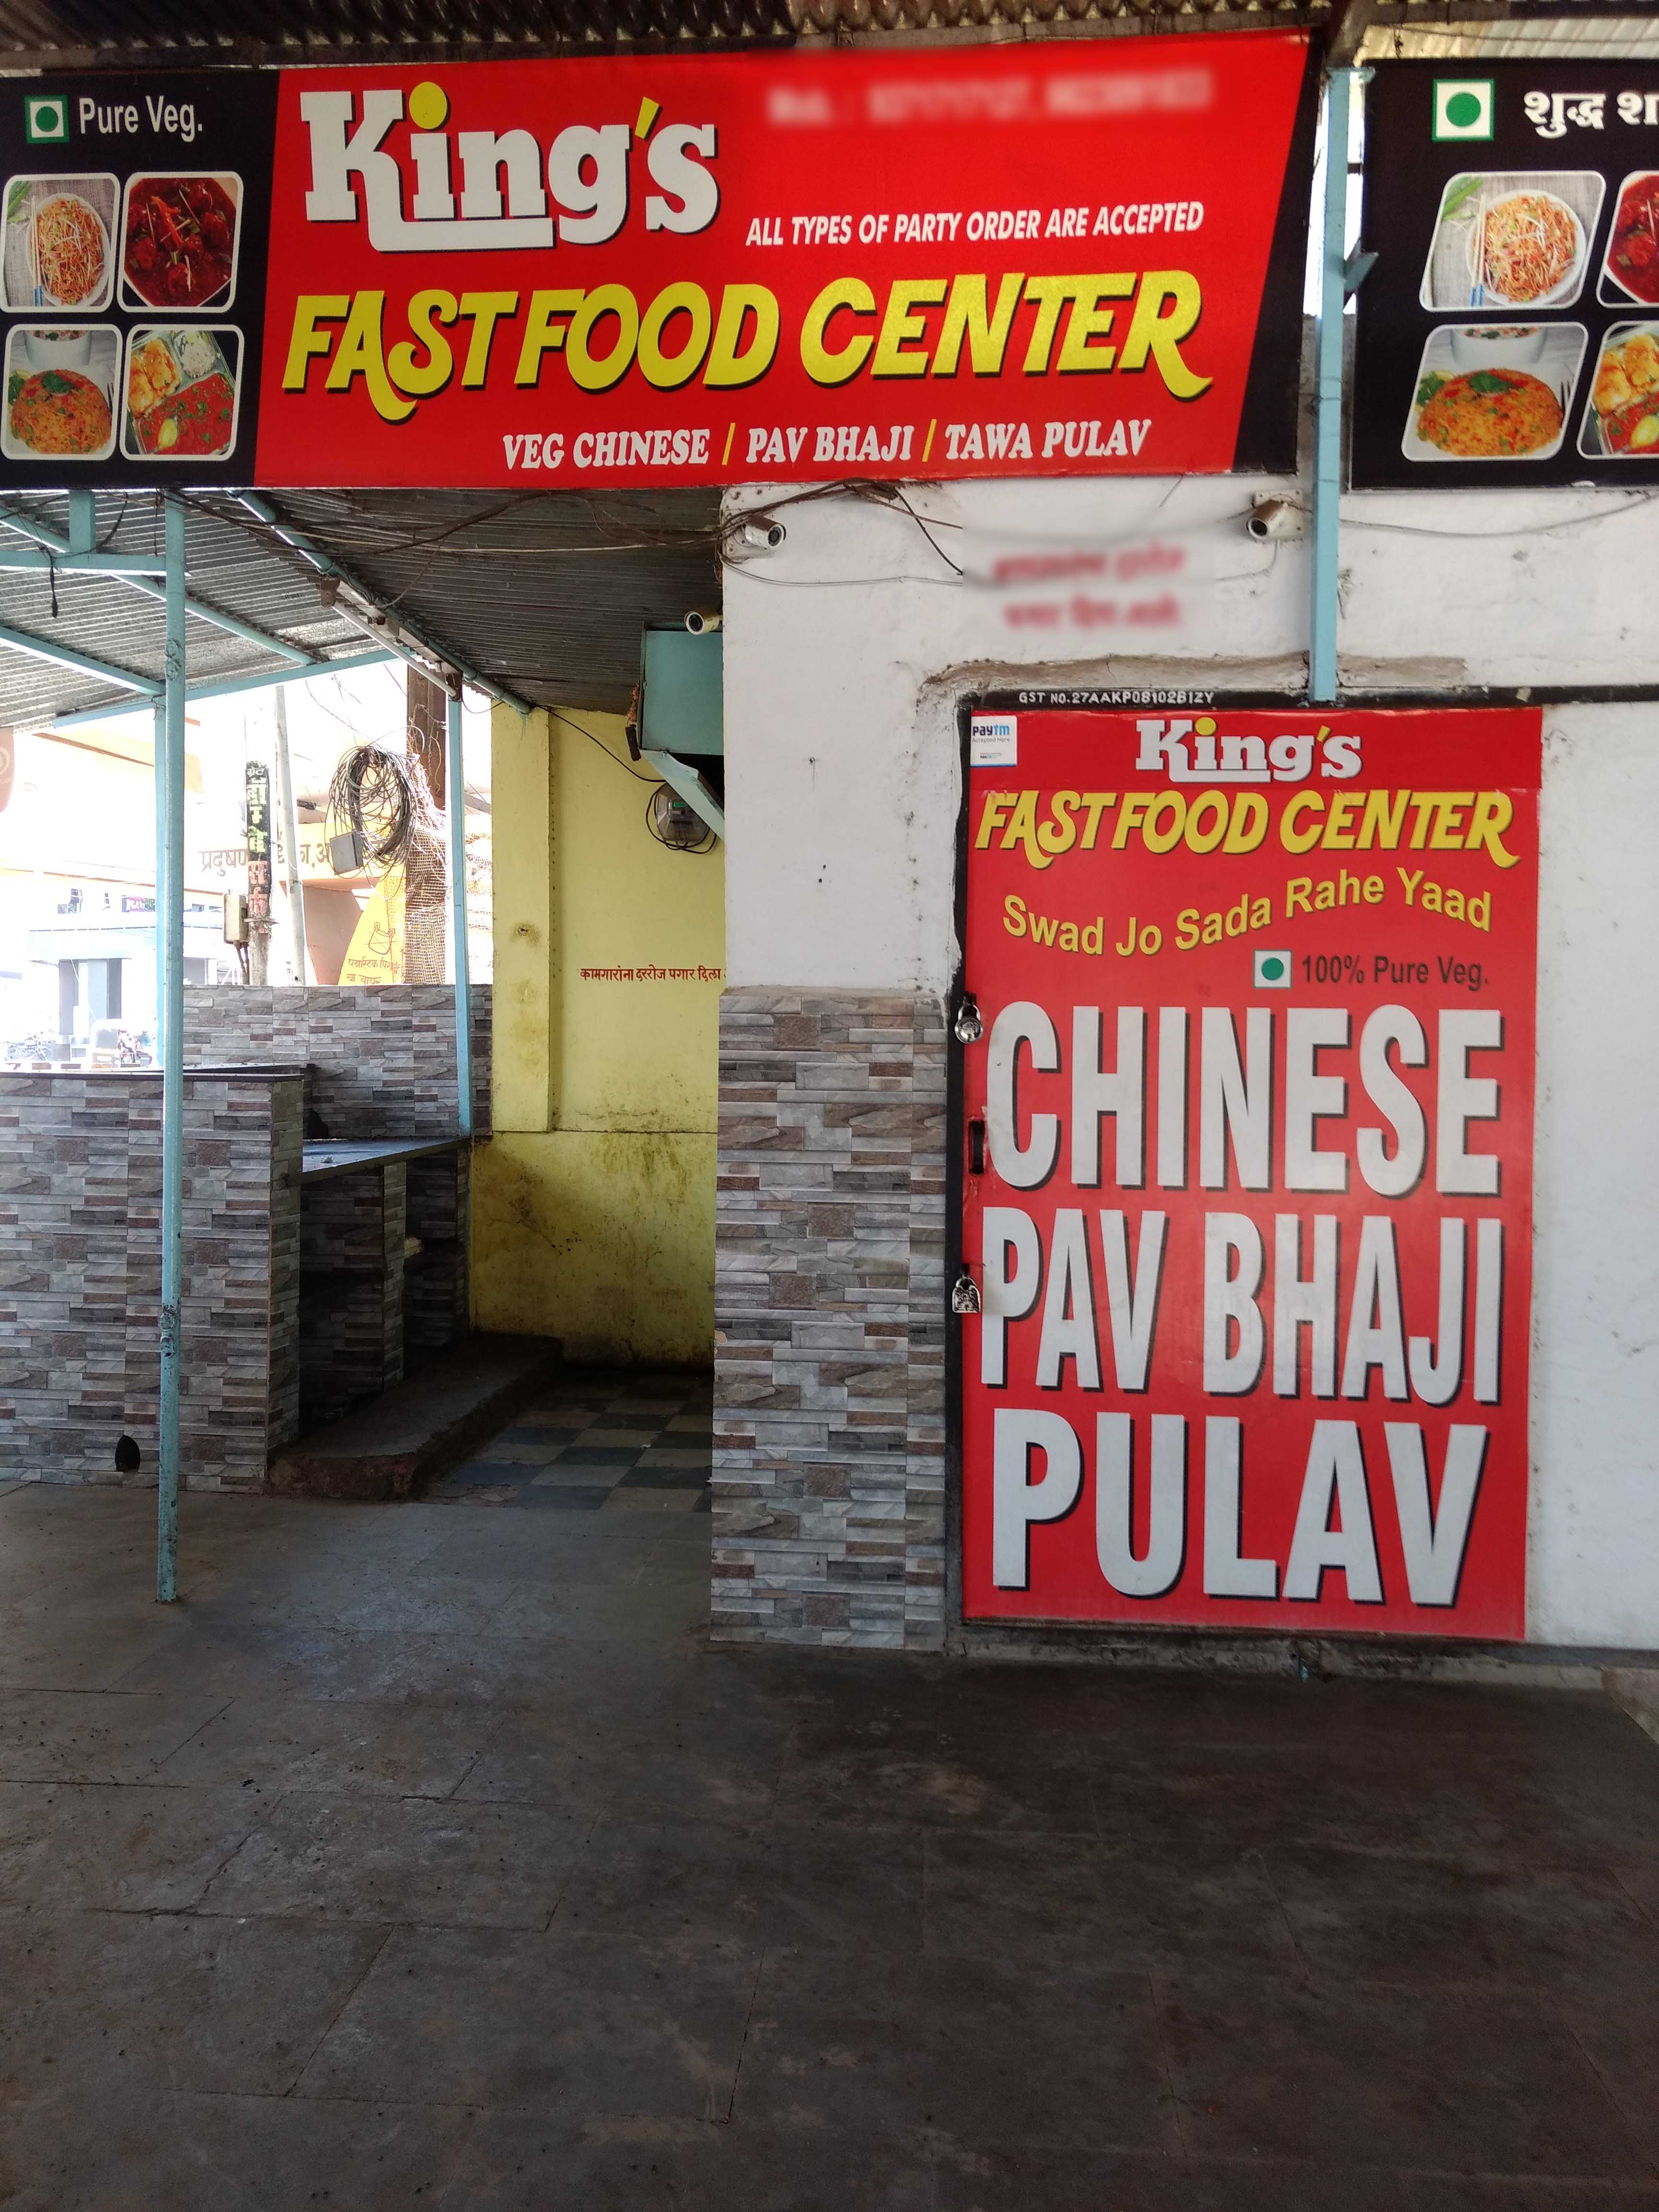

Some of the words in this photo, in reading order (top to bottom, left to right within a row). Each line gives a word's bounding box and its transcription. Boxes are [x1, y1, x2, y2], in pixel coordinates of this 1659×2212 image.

[80, 97, 138, 135] Pure
[145, 96, 203, 142] Veg.
[1524, 91, 1606, 139] शुद्ध
[300, 82, 718, 252] King's
[745, 216, 784, 246] ALL
[791, 215, 853, 245] TYPES
[858, 214, 890, 243] OF
[893, 212, 962, 242] PARTY
[966, 209, 1041, 241] ORDER
[1044, 207, 1089, 238] ARE
[1093, 201, 1204, 236] ACCEPTED
[282, 289, 519, 424] FAST
[514, 281, 780, 392] FOOD
[800, 270, 1214, 401] CENTER
[503, 433, 565, 469] VEG
[573, 428, 710, 468] CHINESE
[745, 426, 808, 464] PAV
[812, 425, 914, 462] BHAJI
[945, 422, 1036, 459] TAWA
[1041, 419, 1152, 457] PULAV
[1019, 691, 1046, 704] GST
[1135, 717, 1362, 782] King's
[975, 790, 1118, 869] FAST
[1111, 790, 1269, 854] FOOD
[1280, 789, 1521, 869] CENTER
[1003, 894, 1104, 955] Swad
[1116, 916, 1162, 957] Jo
[1175, 894, 1272, 951] Sada
[1286, 868, 1385, 919] Rahe
[1397, 867, 1491, 932] Yaad
[580, 965, 634, 982] कामगारांना
[636, 964, 666, 982] दररोज
[668, 968, 695, 981] पगार
[697, 965, 721, 982] दिला
[1301, 956, 1365, 985] 100%
[1373, 955, 1430, 985] Pure
[1438, 955, 1489, 991] Veg.
[986, 1001, 1504, 1198] CHINESE
[981, 1206, 1170, 1392] PAV
[1202, 1212, 1504, 1407] BHAJI
[992, 1408, 1490, 1608] PULAV
